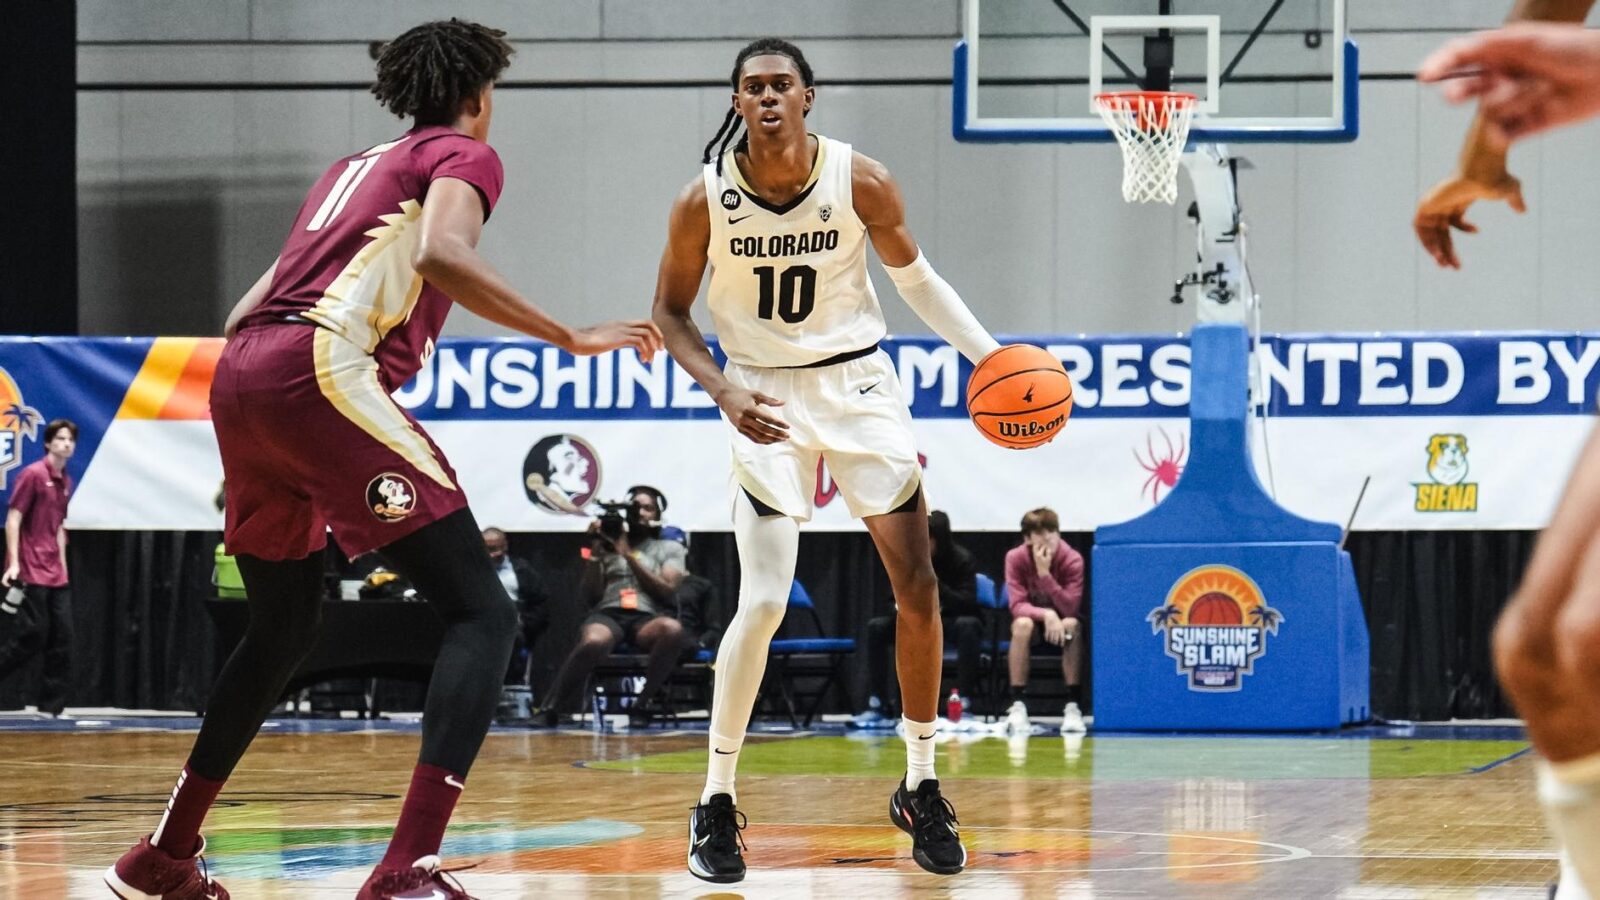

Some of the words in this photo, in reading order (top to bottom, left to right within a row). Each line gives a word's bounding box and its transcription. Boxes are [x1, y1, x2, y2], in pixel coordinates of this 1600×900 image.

[306, 153, 382, 231] 11
[724, 192, 738, 206] BH
[730, 229, 839, 258] COLORADO
[753, 265, 818, 324] 10
[391, 347, 718, 408] UNSHINE
[1497, 340, 1600, 404] BY
[999, 414, 1064, 437] Wilson
[1415, 483, 1478, 512] SIENA
[1171, 627, 1260, 654] SUNSHINE
[1184, 645, 1246, 667] SLAM
